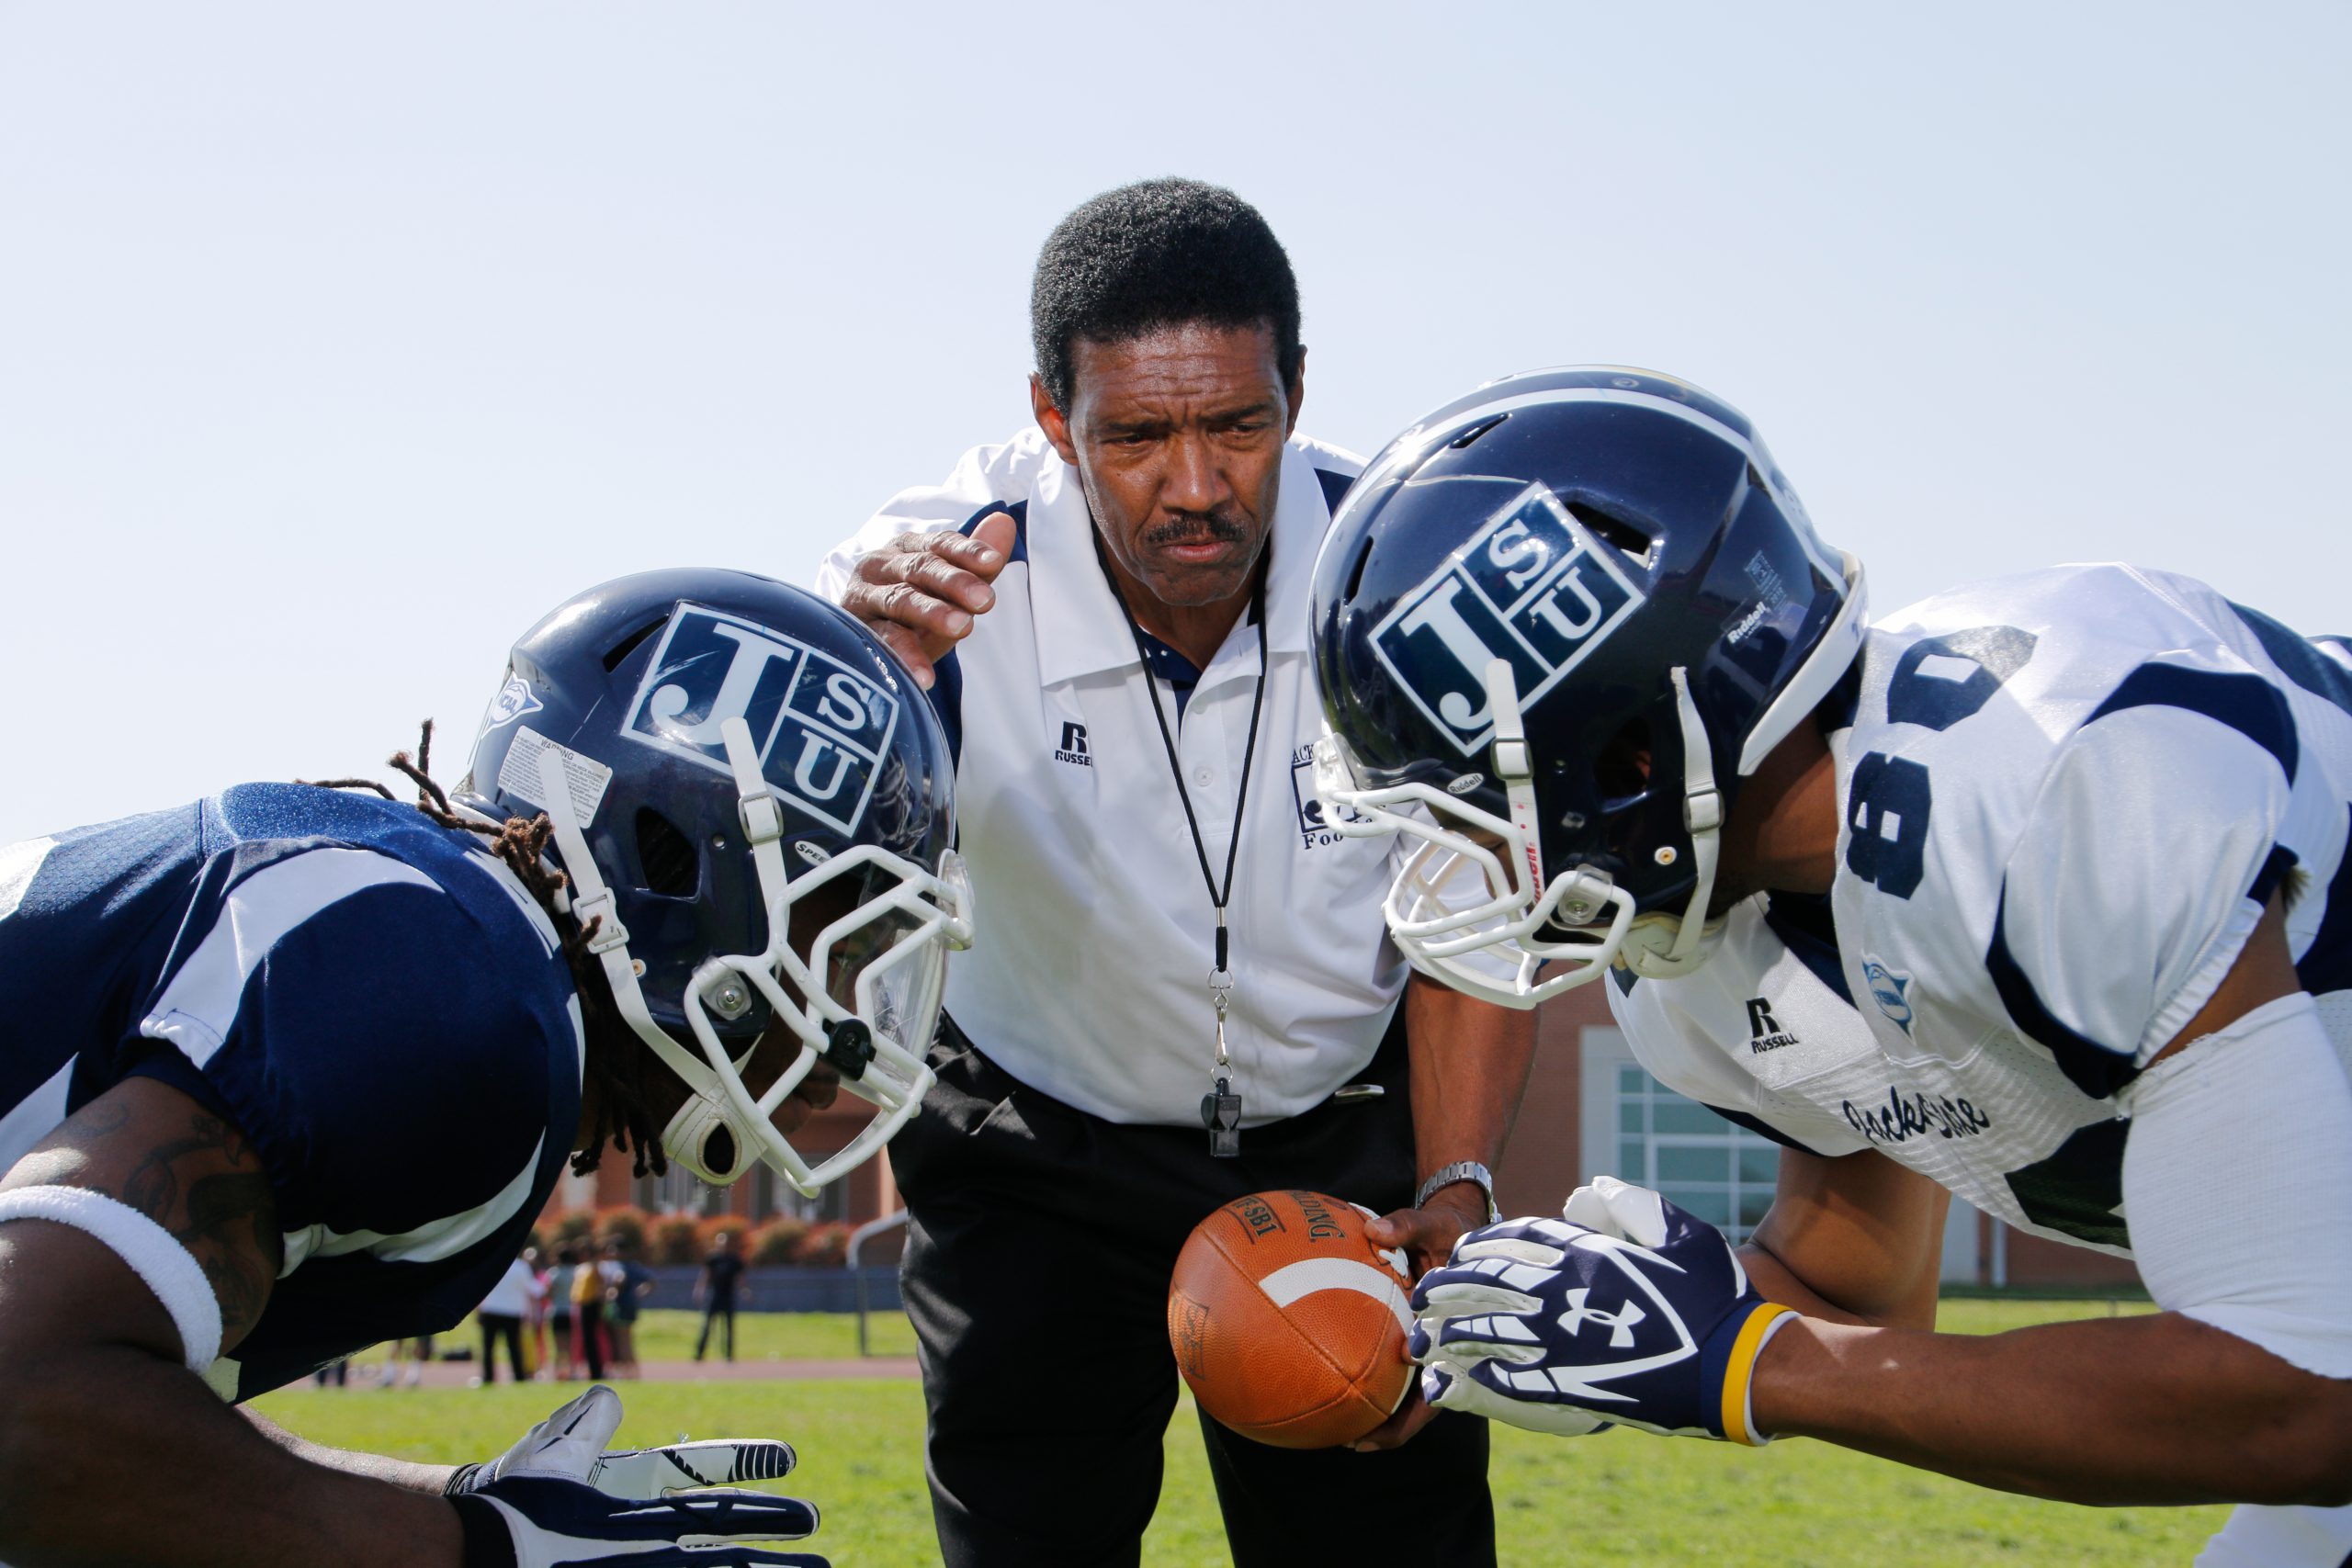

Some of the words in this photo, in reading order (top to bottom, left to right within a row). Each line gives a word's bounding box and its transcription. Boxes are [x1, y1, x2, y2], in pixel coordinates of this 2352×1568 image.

[1727, 601, 1766, 644] Riddell
[1060, 720, 1088, 754] R
[1054, 749, 1093, 769] RUSSE
[1292, 743, 1315, 763] ACK
[1449, 774, 1483, 794] Riddell
[1301, 831, 1344, 851] Foo
[796, 843, 827, 864] SPEE
[1747, 997, 1781, 1038] R
[1750, 1033, 1800, 1055] RUSSELL
